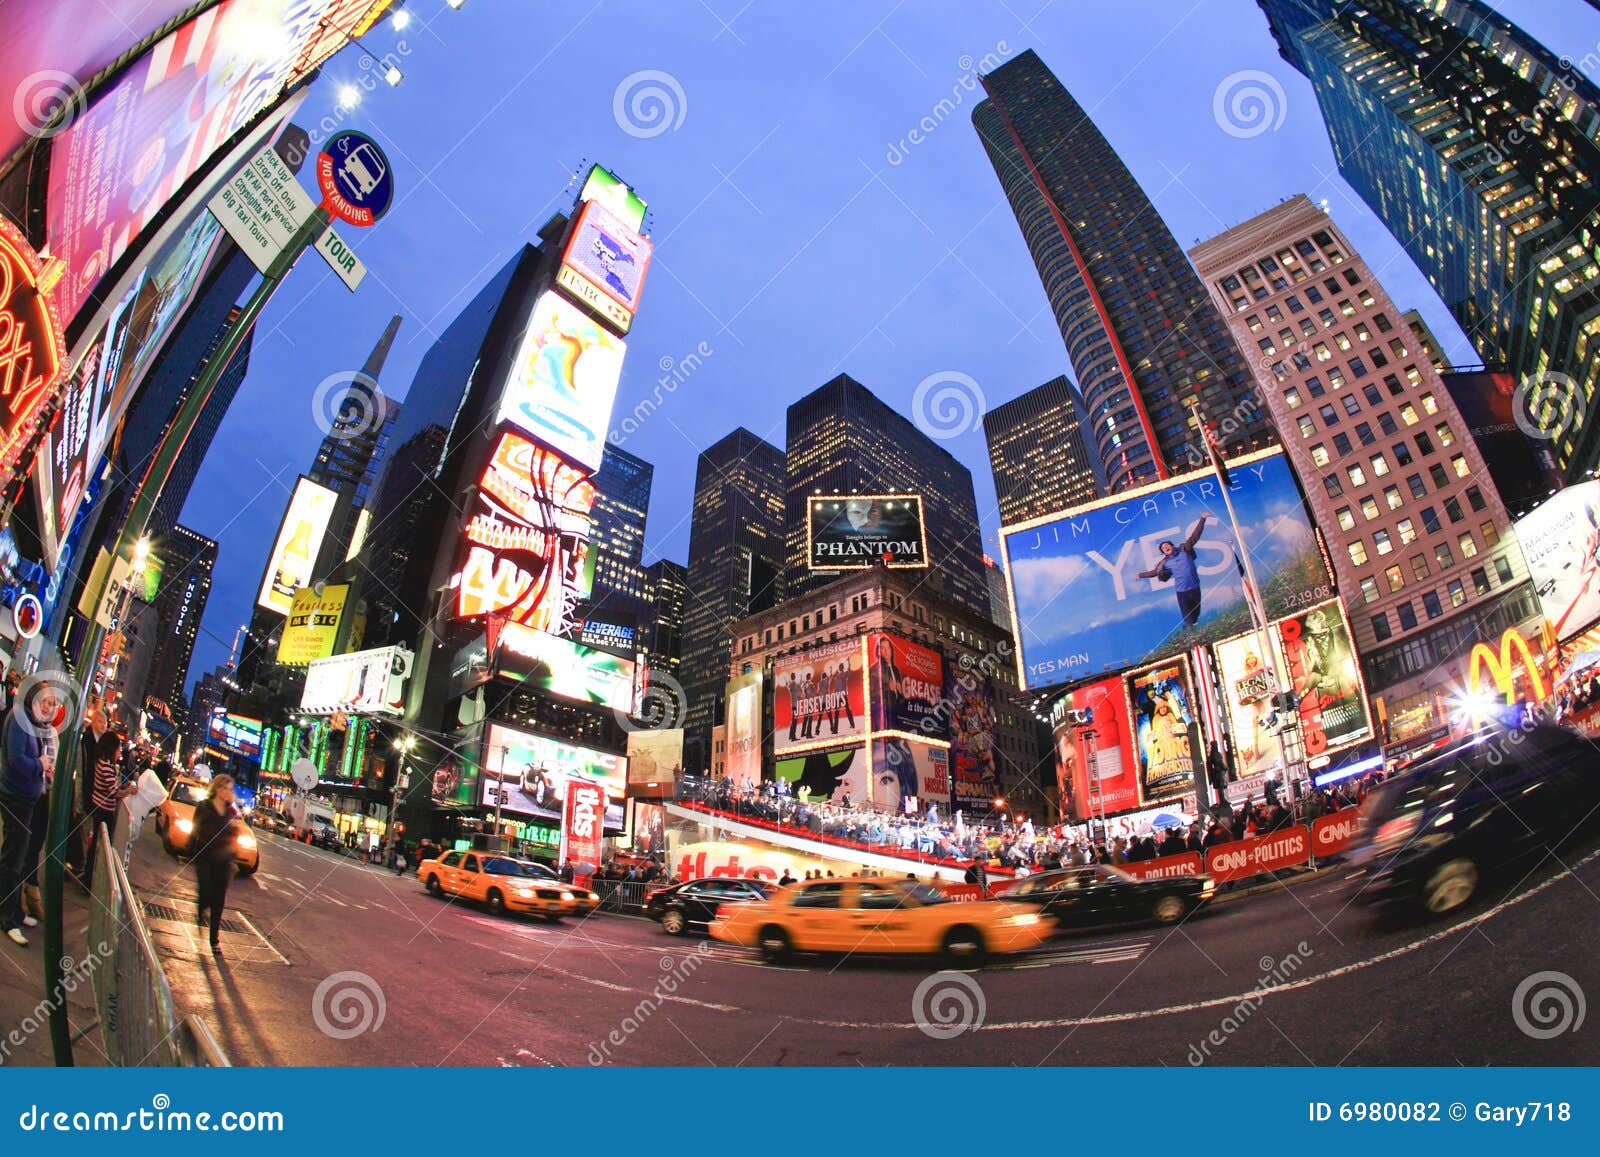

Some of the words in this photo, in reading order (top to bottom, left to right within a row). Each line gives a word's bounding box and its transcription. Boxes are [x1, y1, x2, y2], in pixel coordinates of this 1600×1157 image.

[263, 146, 280, 170] Pick
[277, 166, 292, 183] Up/
[322, 160, 333, 177] NO
[243, 168, 255, 182] NY
[251, 177, 263, 192] Air
[259, 187, 273, 208] Port
[271, 203, 296, 235] Service/
[255, 157, 271, 179] Drop
[270, 175, 282, 191] Off
[280, 190, 297, 212] Only
[325, 181, 369, 222] STANDING
[221, 188, 236, 209] Big
[233, 204, 250, 225] Taxi
[248, 222, 269, 248] Tours
[234, 178, 263, 215] Citysights
[261, 211, 273, 226] NY
[323, 231, 357, 275] TOUR
[562, 270, 600, 304] HSBC
[814, 540, 918, 556] PHANTOM
[1031, 515, 1093, 551] JIM
[1086, 516, 1234, 602] YES
[175, 583, 196, 636] NOVOTEL
[292, 598, 343, 613] Fearless
[1283, 584, 1330, 609] 12.19.08
[293, 615, 336, 625] MUSIC
[583, 620, 635, 639] LEVERAGE
[581, 632, 600, 641] NEW
[603, 635, 633, 645] SERIES
[775, 654, 806, 668] BEST
[809, 638, 862, 660] MUSICAL
[1029, 660, 1055, 677] YES
[1057, 651, 1090, 671] MAN
[793, 694, 824, 717] JERSEY
[825, 690, 849, 711] BOYS
[901, 676, 942, 706] GREASE
[574, 787, 600, 838] tkts
